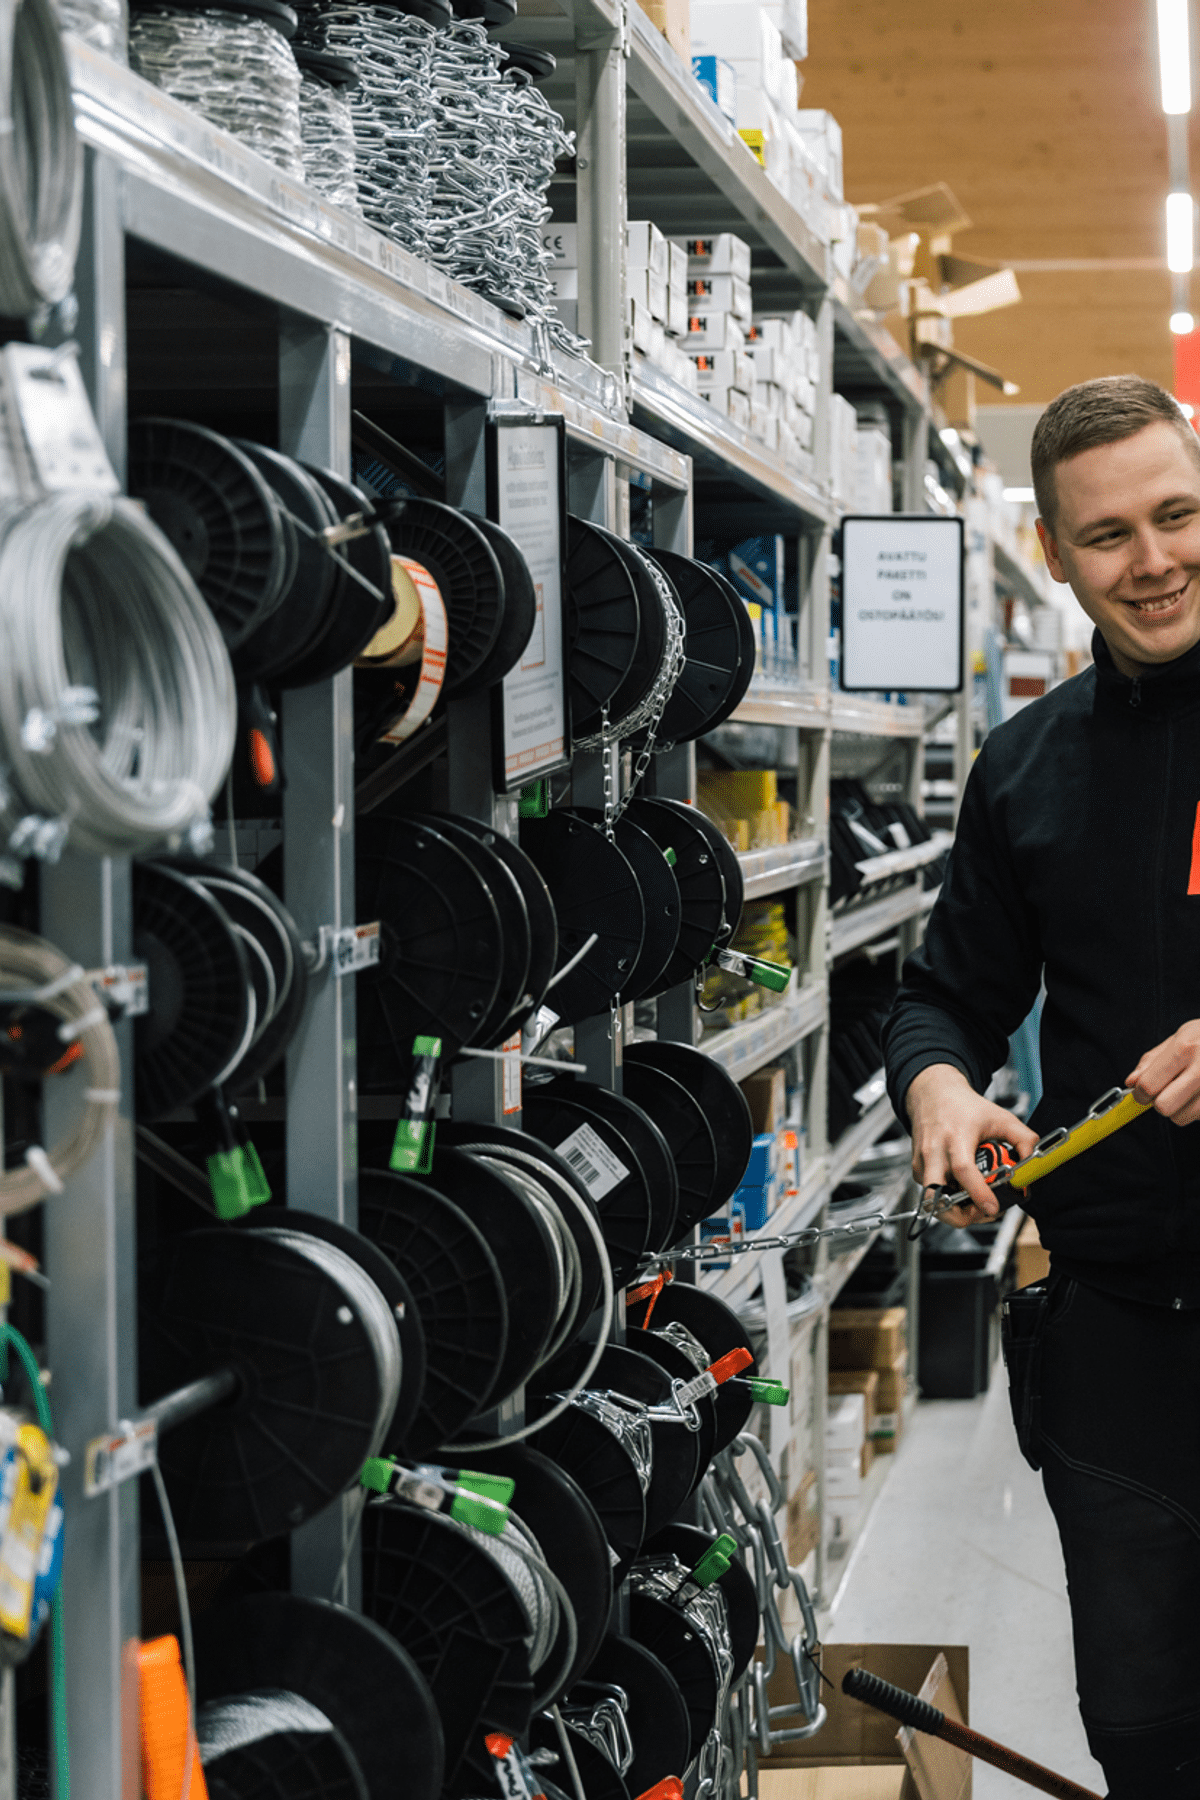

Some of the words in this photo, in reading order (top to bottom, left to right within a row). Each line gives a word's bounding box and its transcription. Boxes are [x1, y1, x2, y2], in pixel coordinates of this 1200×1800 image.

[543, 236, 562, 250] CE
[877, 550, 928, 562] AVATTU
[876, 569, 928, 581] PAKETTI
[891, 590, 912, 601] ON
